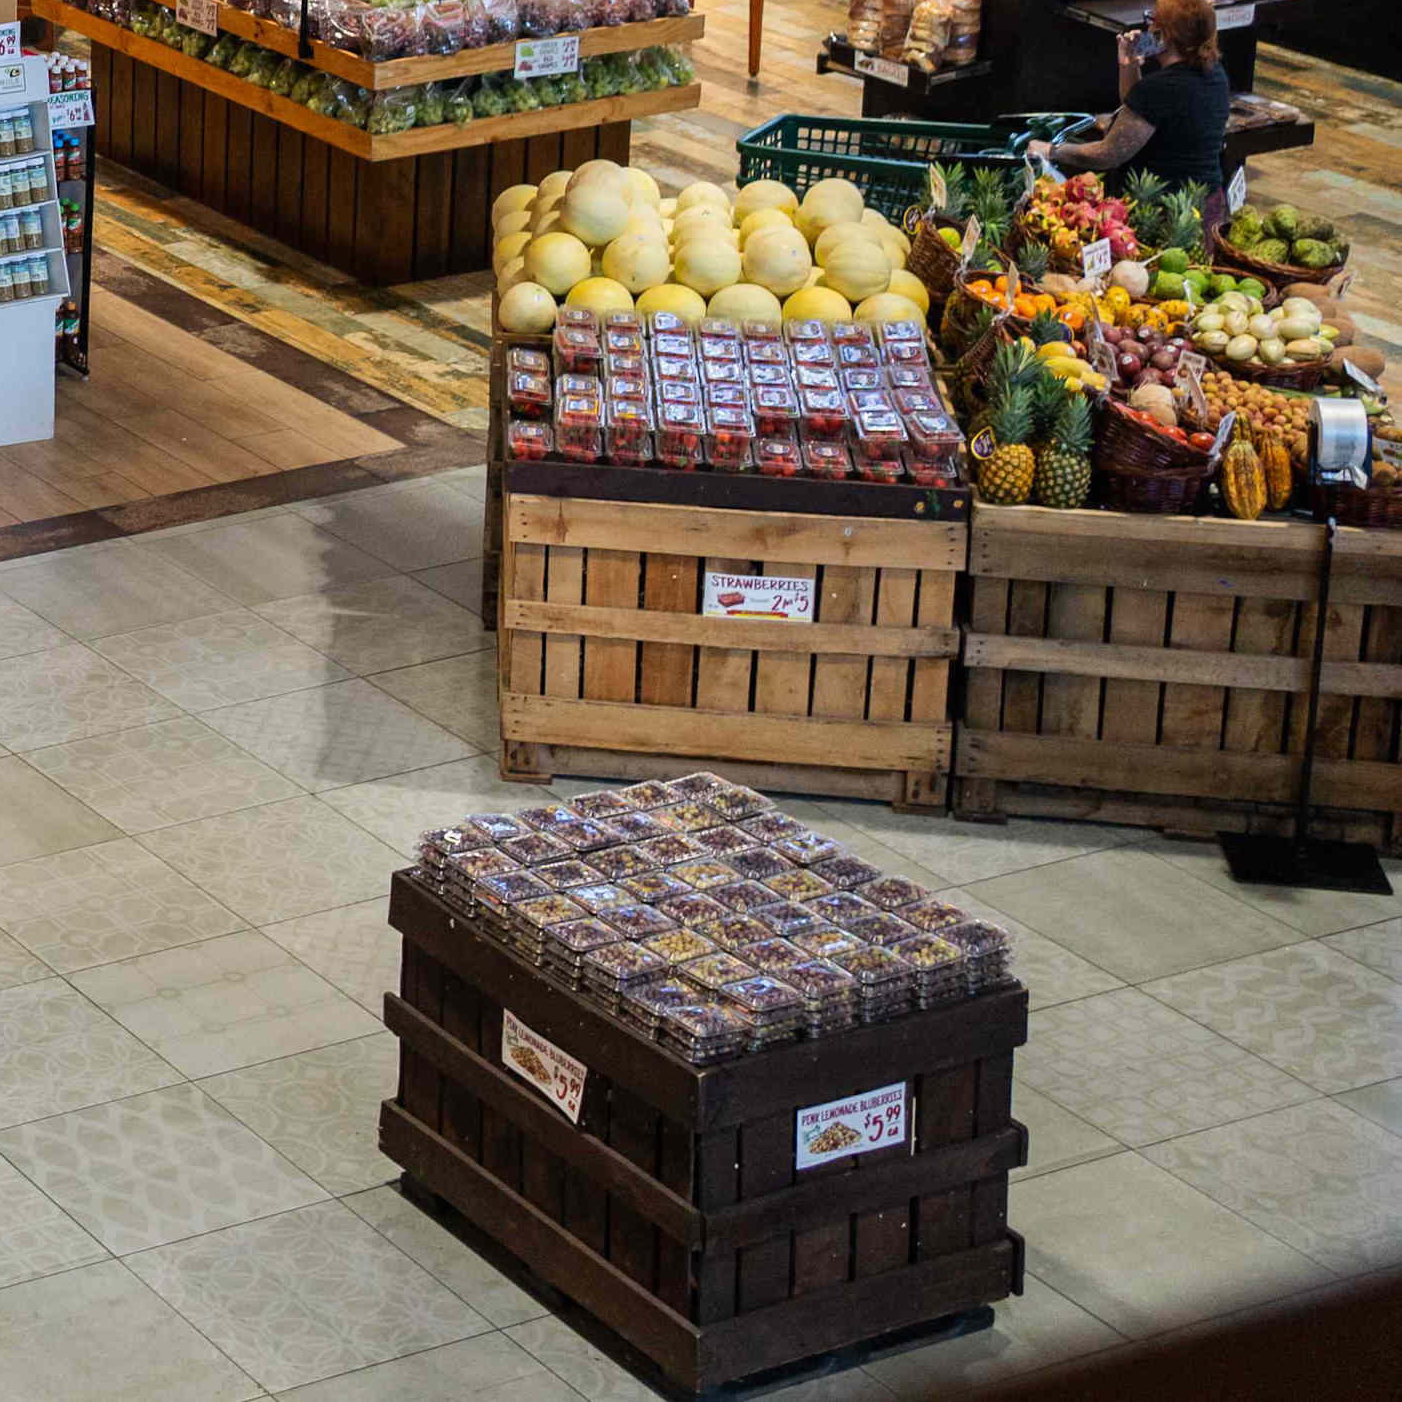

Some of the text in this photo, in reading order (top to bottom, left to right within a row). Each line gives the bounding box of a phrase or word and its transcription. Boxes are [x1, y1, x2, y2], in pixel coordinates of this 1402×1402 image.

[711, 574, 809, 592] STRAWBERRIES
[771, 595, 783, 612] 2
[802, 1114, 822, 1127] PINK
[821, 1101, 858, 1121] LEMONADE
